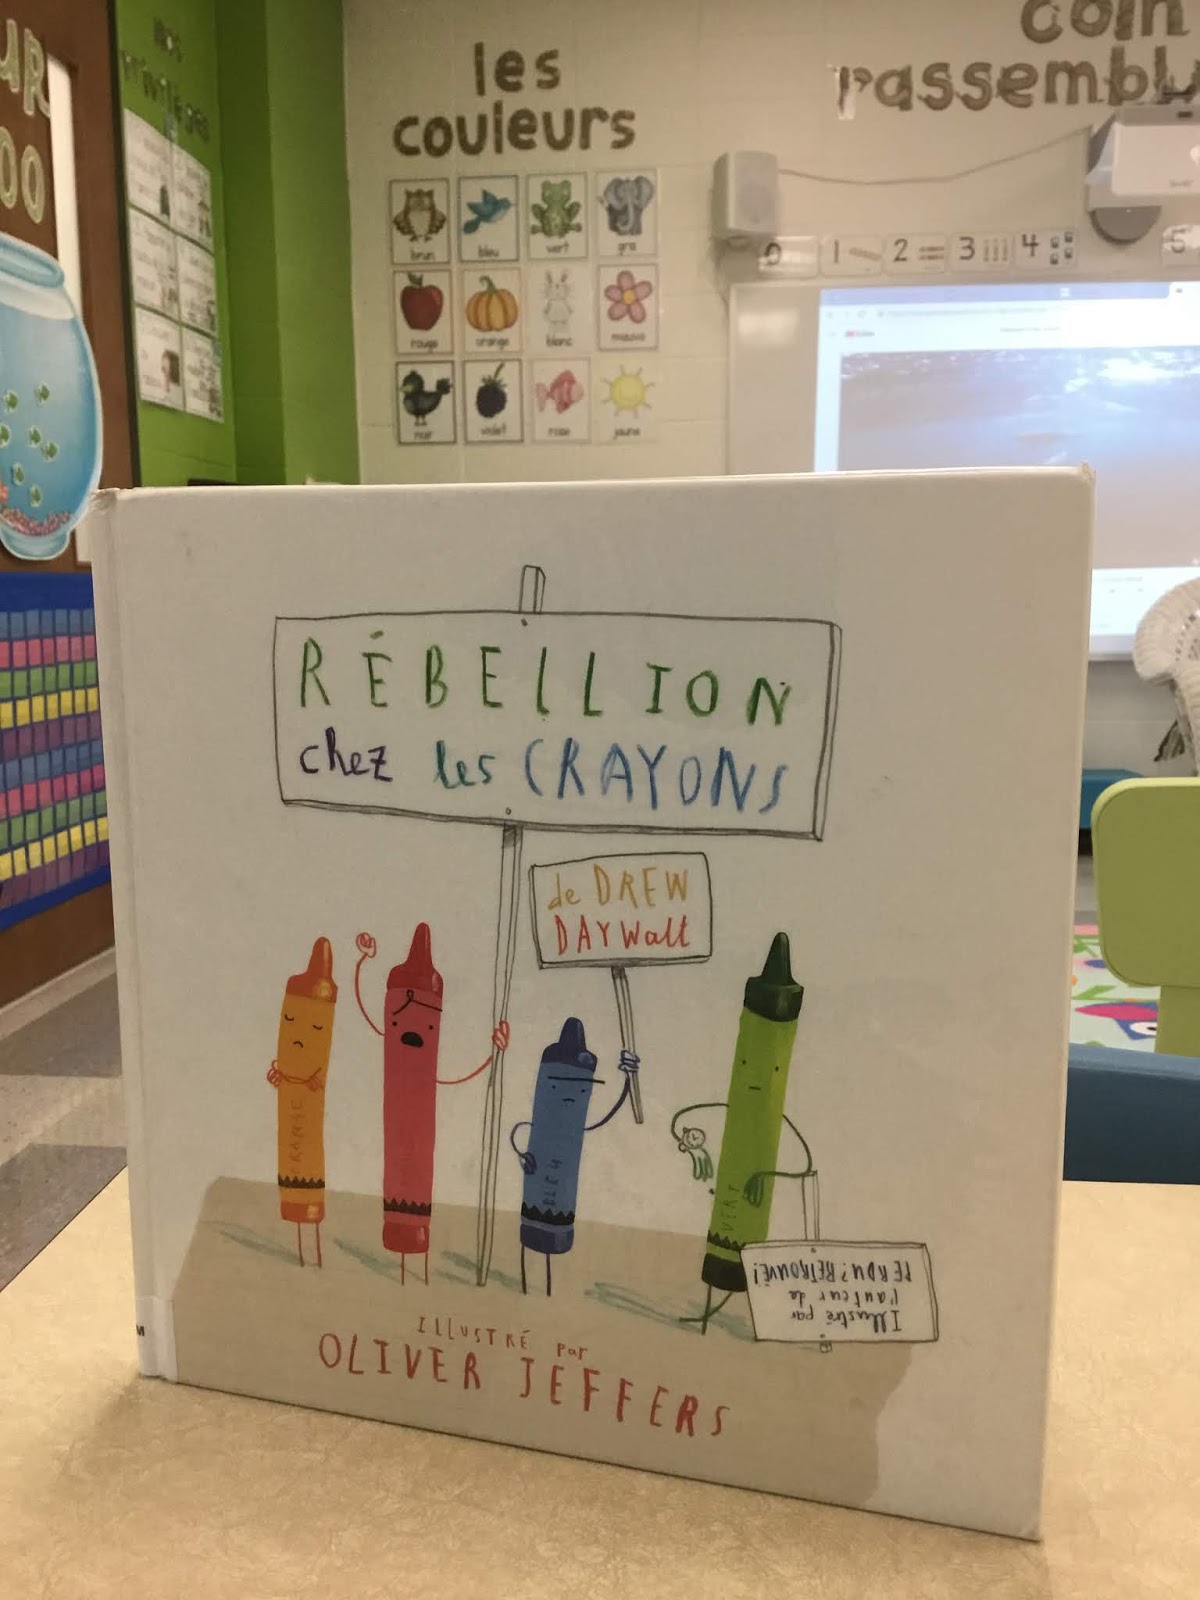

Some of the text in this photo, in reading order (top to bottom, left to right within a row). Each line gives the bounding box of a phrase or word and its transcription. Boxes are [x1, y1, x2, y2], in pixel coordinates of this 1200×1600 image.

[1021, 0, 1190, 43] coin
[474, 42, 561, 96] les
[837, 46, 1200, 116] rassembl
[393, 100, 636, 157] couleurs
[477, 246, 499, 258] bleu
[546, 242, 570, 254] vert
[833, 240, 841, 264] 1
[893, 238, 908, 262] 2
[958, 236, 976, 260] 3
[1021, 234, 1039, 257] 4
[1171, 228, 1187, 254] 5
[410, 338, 438, 352] rouge
[476, 337, 509, 351] orange
[546, 335, 572, 347] blanc
[481, 424, 507, 437] violet
[613, 426, 641, 440] jaune
[300, 630, 792, 727] RÉBELLION
[300, 726, 789, 814] chez les CRAYONS
[547, 863, 689, 910] de DREW
[721, 1183, 741, 1232] VERT
[789, 1289, 807, 1307] de
[791, 1304, 902, 1333] Illustré par
[417, 1315, 531, 1350] ILLUSTRÉ
[318, 1332, 731, 1437] OLIVER JEFFERS
